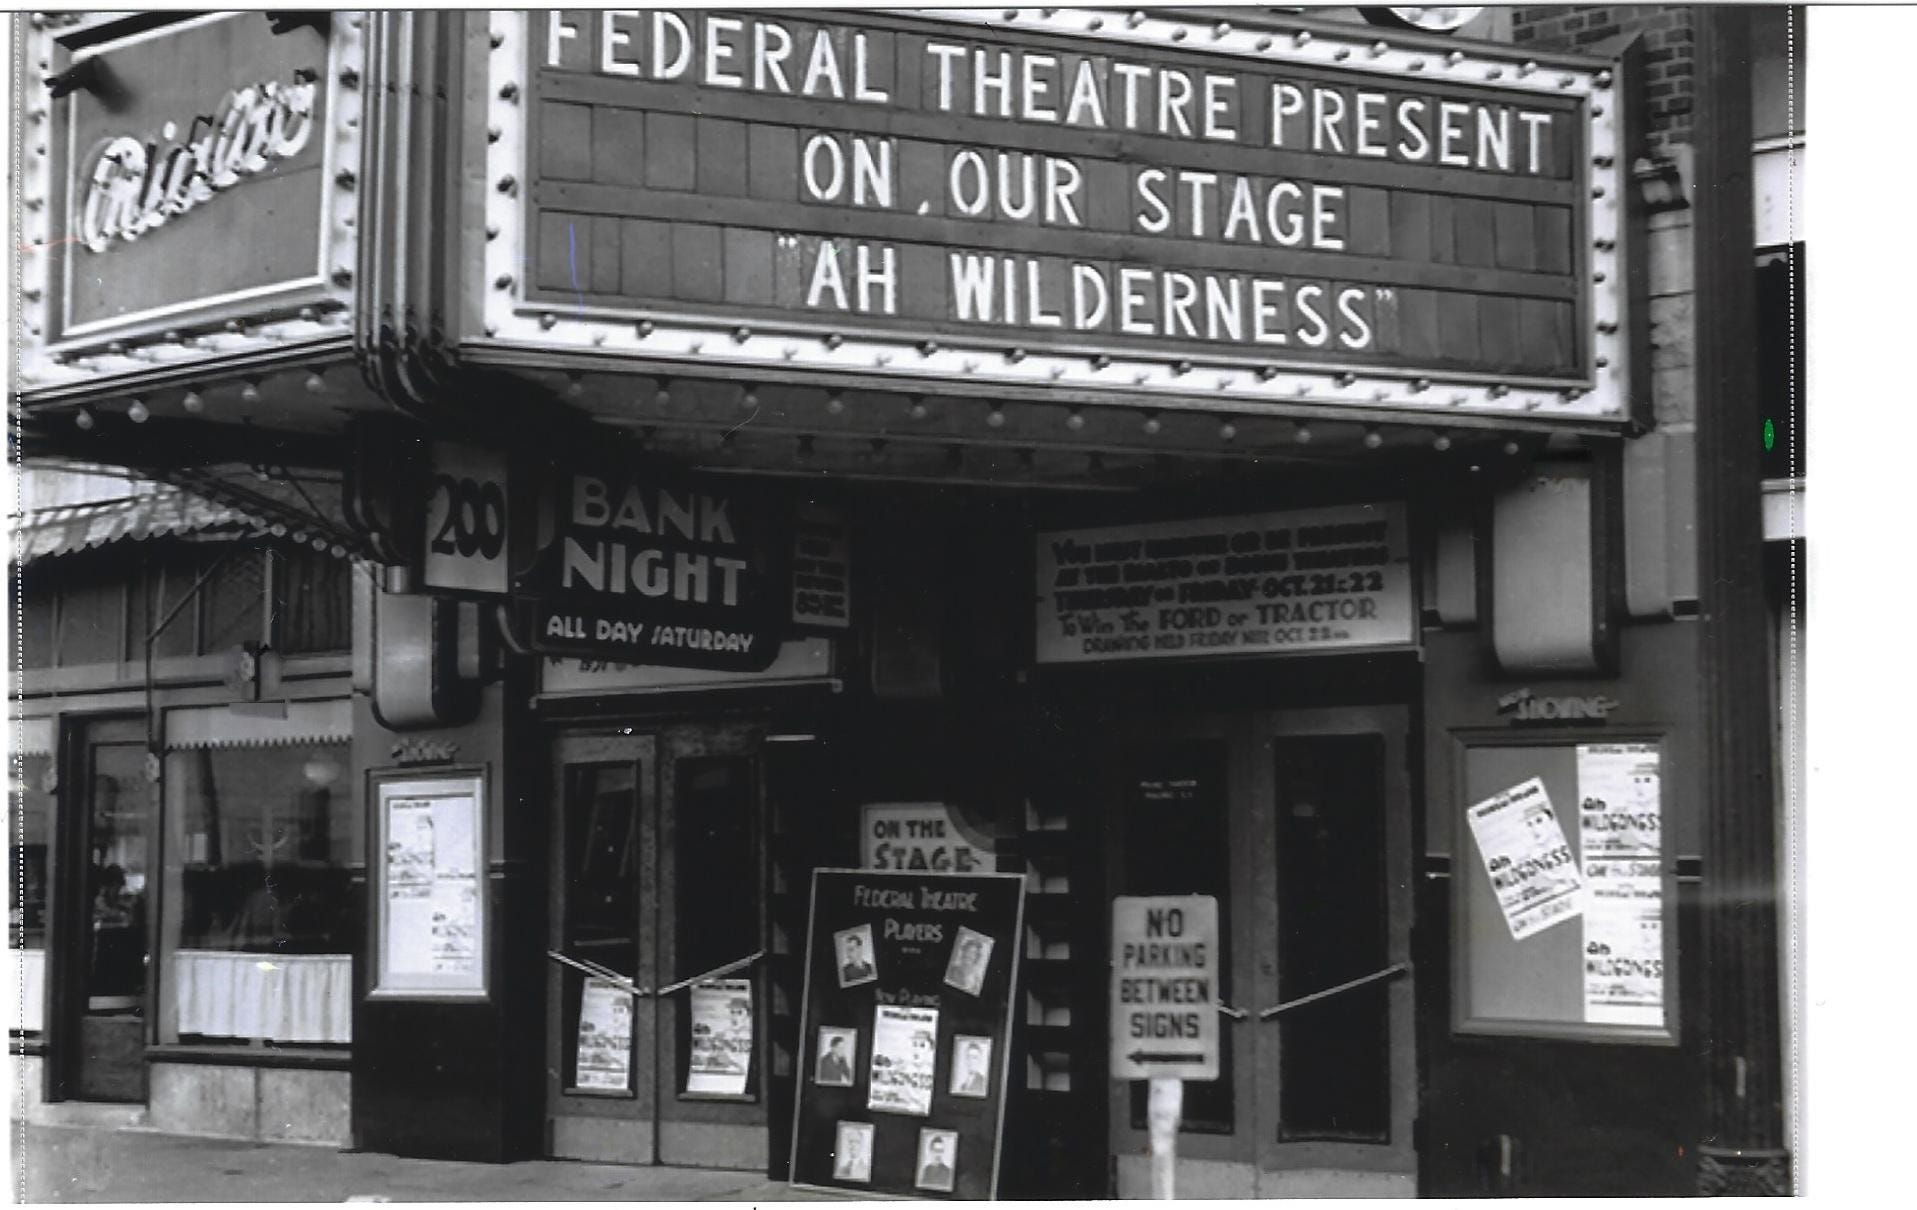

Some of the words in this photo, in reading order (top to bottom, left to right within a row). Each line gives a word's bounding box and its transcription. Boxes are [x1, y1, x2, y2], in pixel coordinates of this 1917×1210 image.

[547, 9, 888, 102] FEDERAL
[926, 42, 1237, 141] THEATRE
[1272, 82, 1552, 174] PRESENT
[803, 134, 891, 207] ON
[949, 150, 1082, 225] OUR
[1136, 168, 1344, 249] STAGE
[430, 473, 507, 561] 200
[572, 474, 736, 545] BANK
[562, 536, 747, 606] NIGHT
[1159, 607, 1221, 631] FORD
[1256, 597, 1378, 626] TRACTOR
[546, 614, 587, 641] ALL
[595, 618, 645, 645] DAY
[650, 622, 755, 654] SATURDAY
[873, 820, 899, 839] ON
[906, 819, 946, 839] THE
[874, 842, 975, 873] STAGE
[1146, 907, 1184, 939] NO
[1122, 942, 1207, 969] PARKING
[1120, 978, 1210, 1005] BETWEEN
[1129, 1012, 1201, 1039] SIGNS
